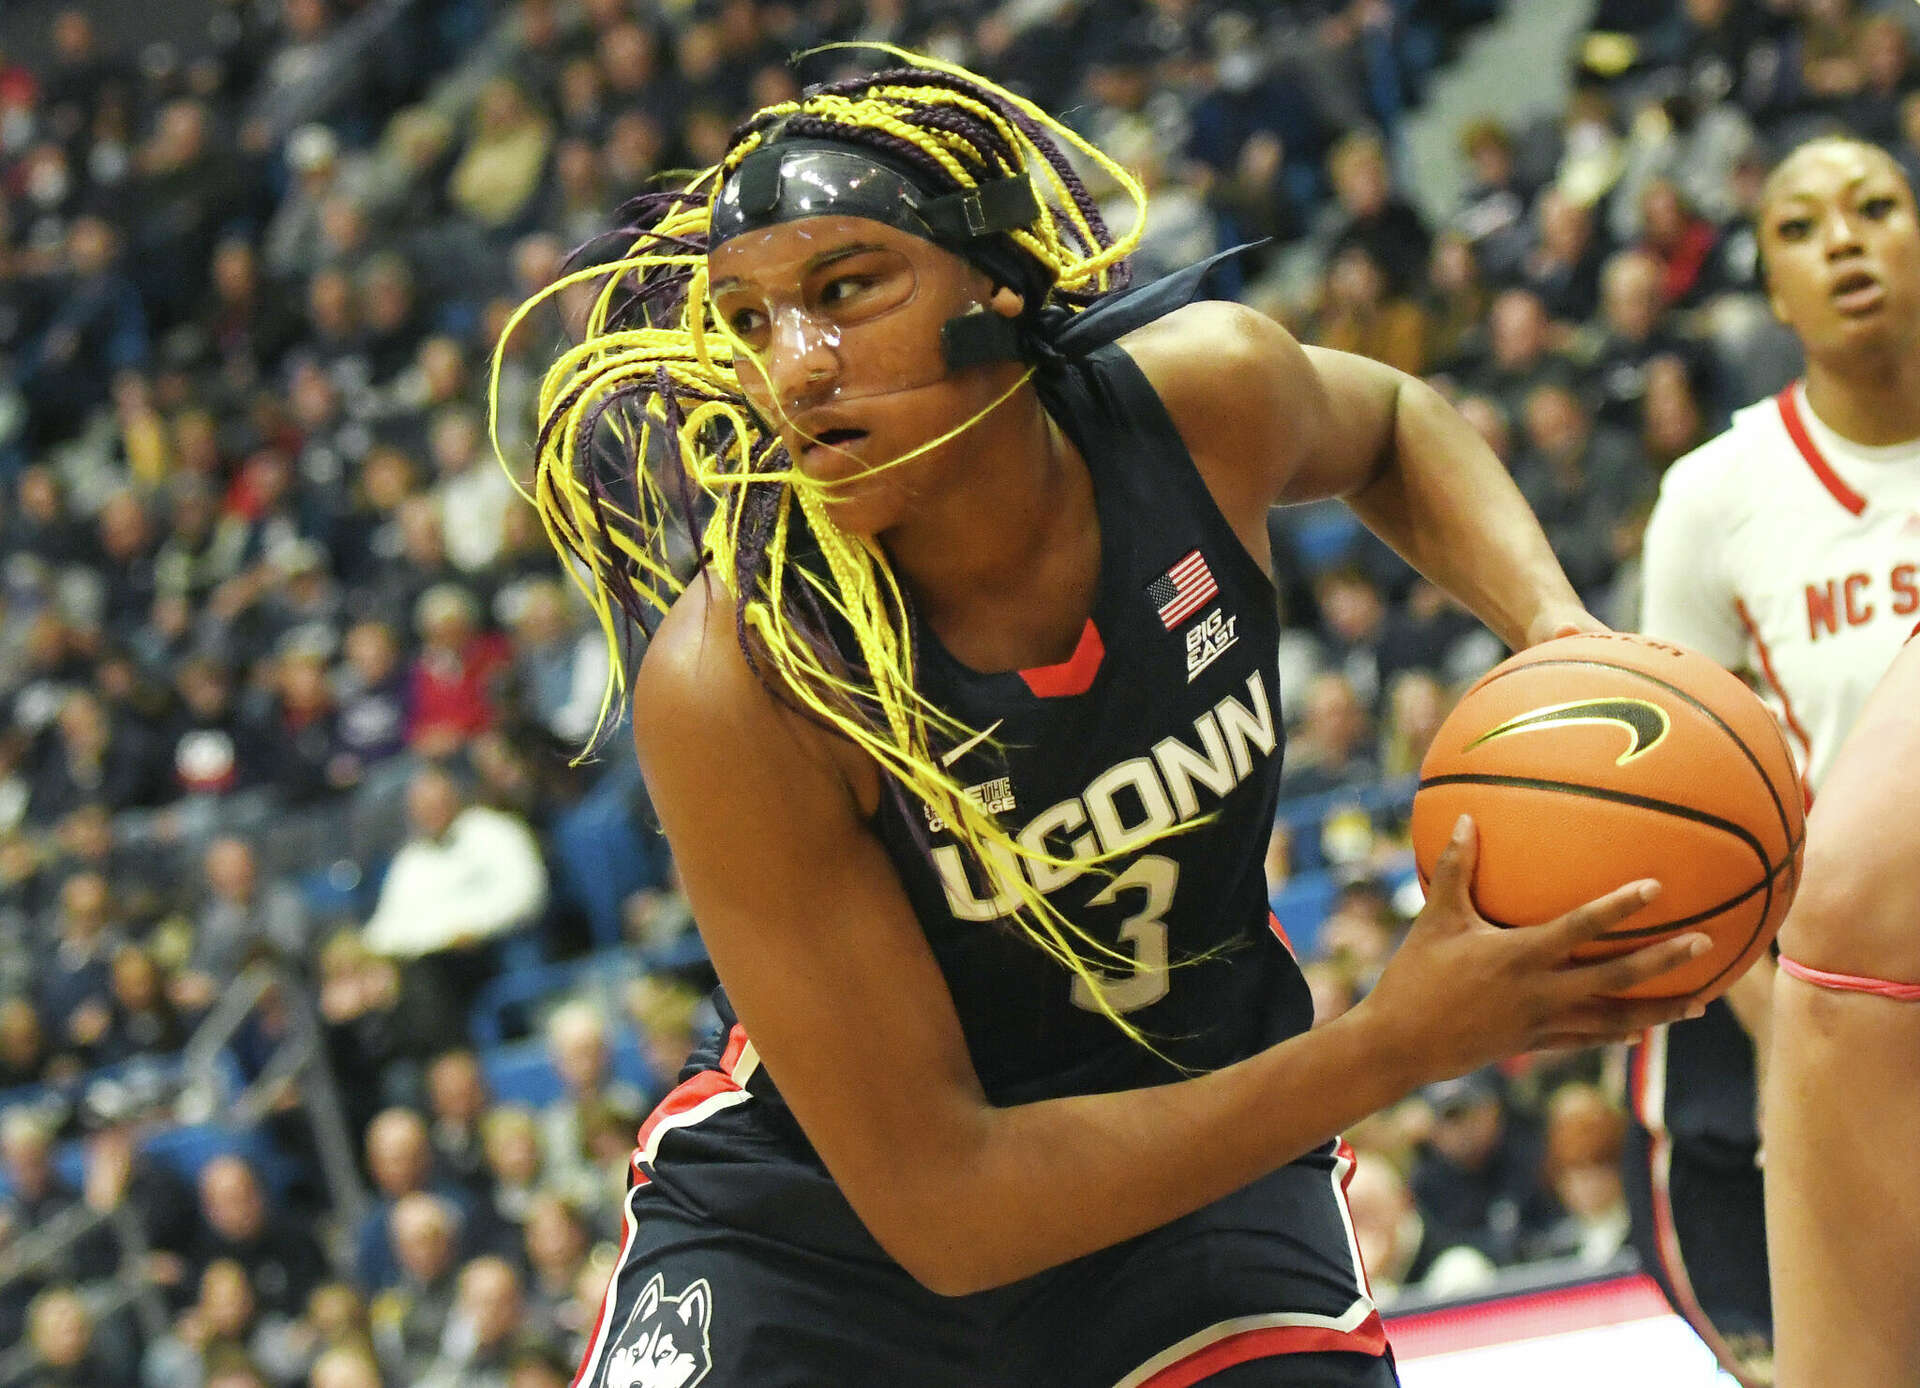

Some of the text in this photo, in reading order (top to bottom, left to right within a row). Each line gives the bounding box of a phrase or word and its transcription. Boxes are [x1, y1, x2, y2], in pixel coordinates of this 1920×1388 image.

[1186, 607, 1222, 653] BIG
[1805, 572, 1873, 641] NC
[1187, 614, 1237, 673] EAST
[931, 669, 1277, 922] UCONN
[980, 776, 1012, 803] THE
[1069, 854, 1180, 1015] 3
